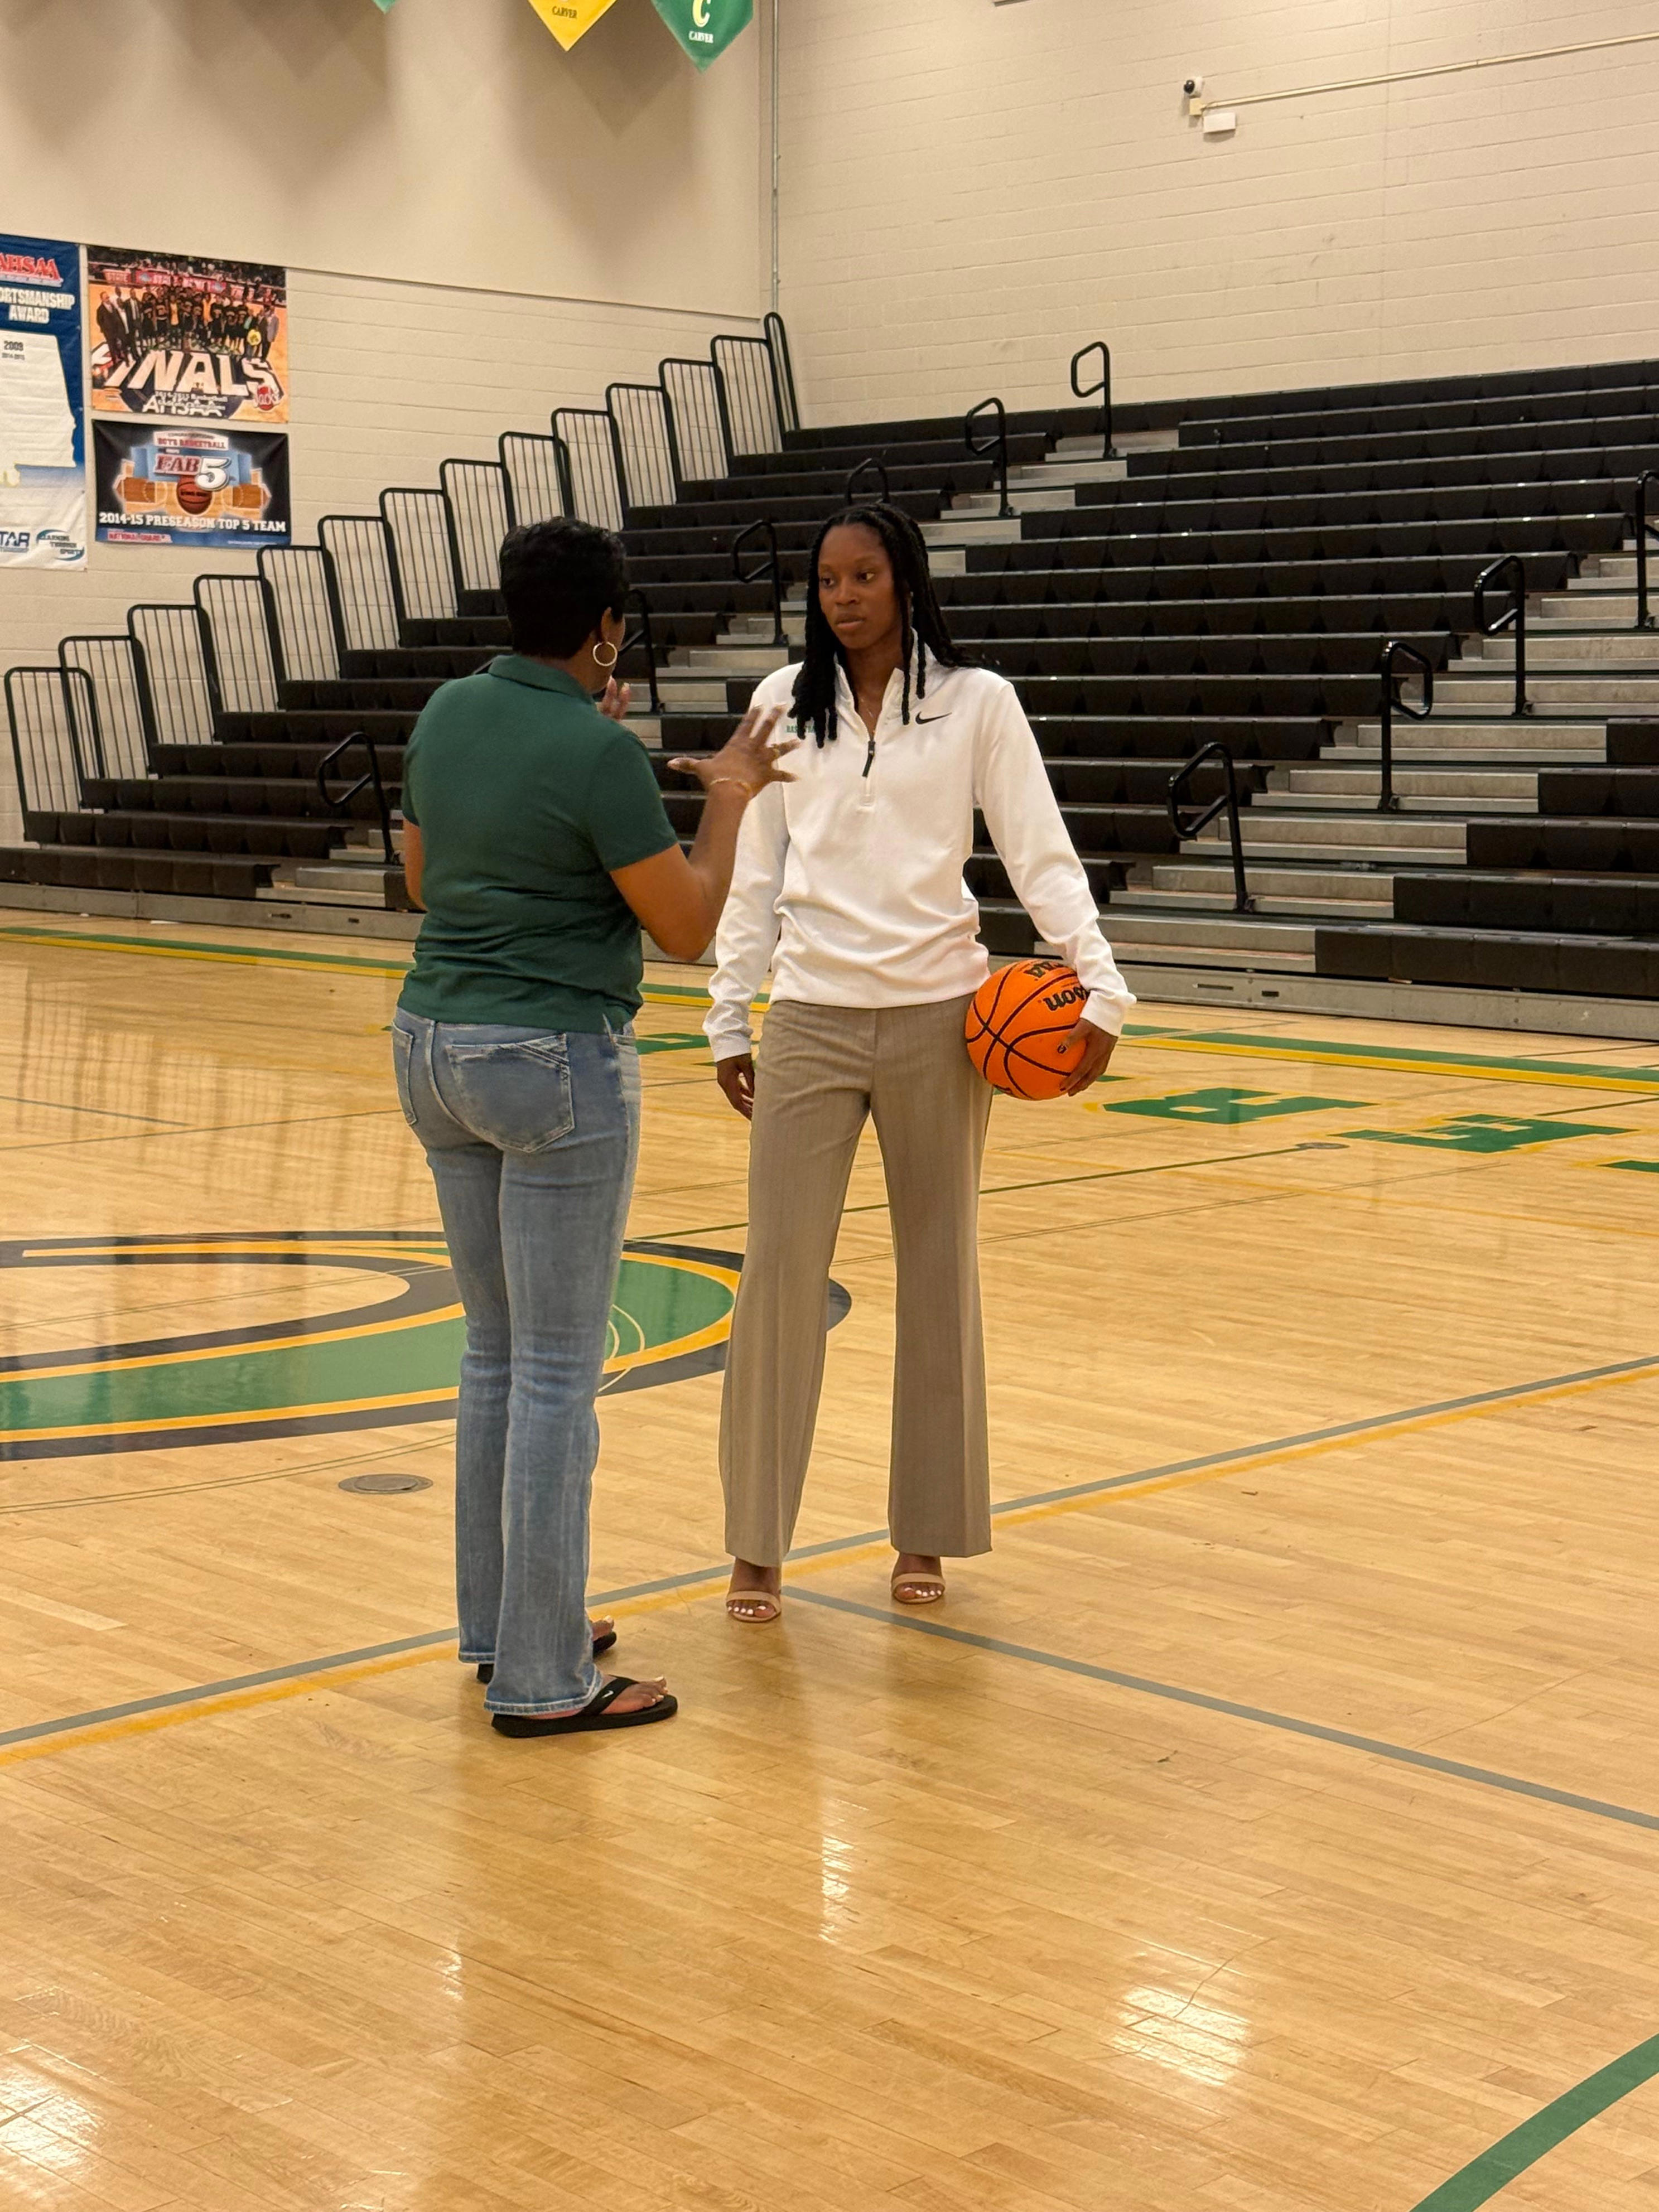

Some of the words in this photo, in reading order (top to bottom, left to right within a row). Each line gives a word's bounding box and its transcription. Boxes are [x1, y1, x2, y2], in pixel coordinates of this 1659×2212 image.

[552, 6, 577, 18] CARVER
[688, 31, 713, 44] CARVER
[8, 305, 50, 323] AWARD
[180, 439, 226, 450] BASKETBALL
[155, 455, 200, 475] FAB
[196, 456, 232, 491] 5
[99, 511, 144, 525] 2014-15
[146, 514, 216, 529] PRESEASON
[217, 518, 241, 530] TOP
[242, 519, 252, 531] 5
[252, 520, 288, 533] TEAM
